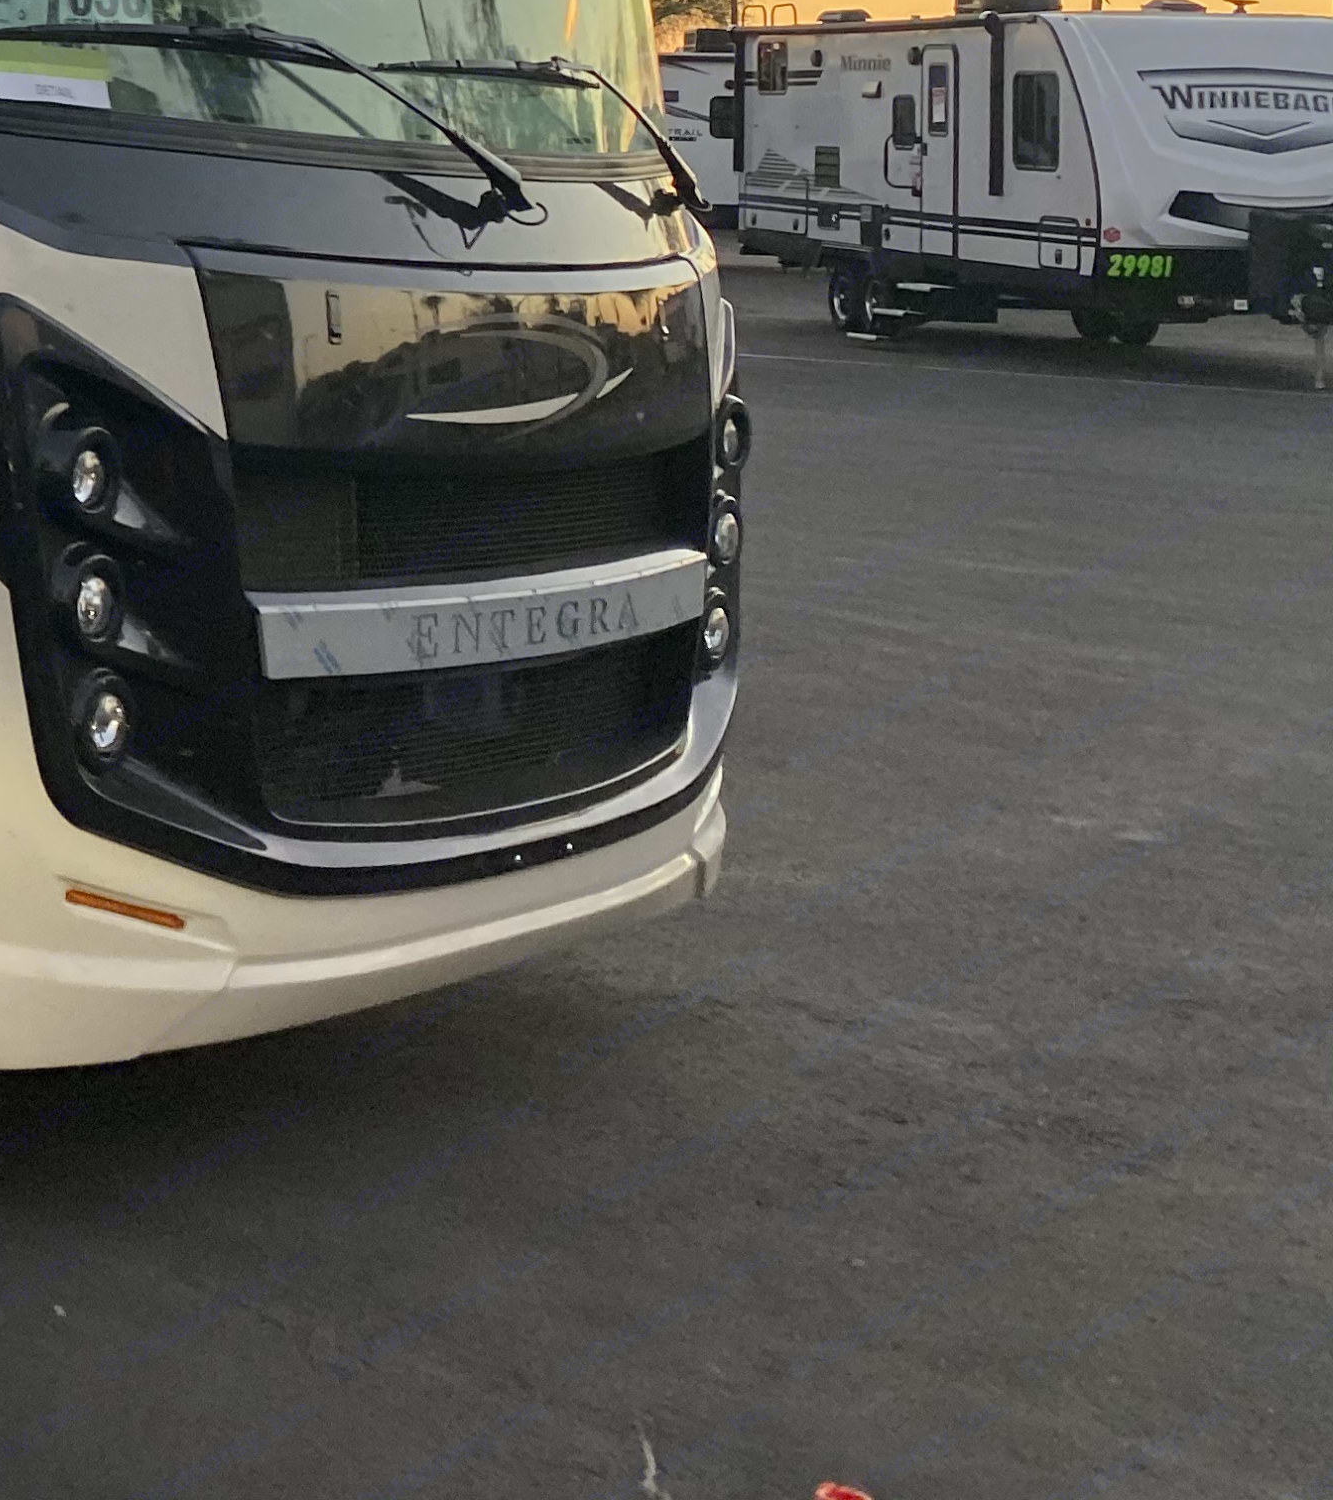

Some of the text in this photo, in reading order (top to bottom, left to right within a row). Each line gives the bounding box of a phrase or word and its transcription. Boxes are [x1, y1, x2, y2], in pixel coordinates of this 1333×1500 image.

[841, 54, 891, 72] Minnie
[1151, 85, 1333, 113] WINNEBAG
[1107, 254, 1174, 278] 29981
[414, 591, 640, 660] ENTEGRA
